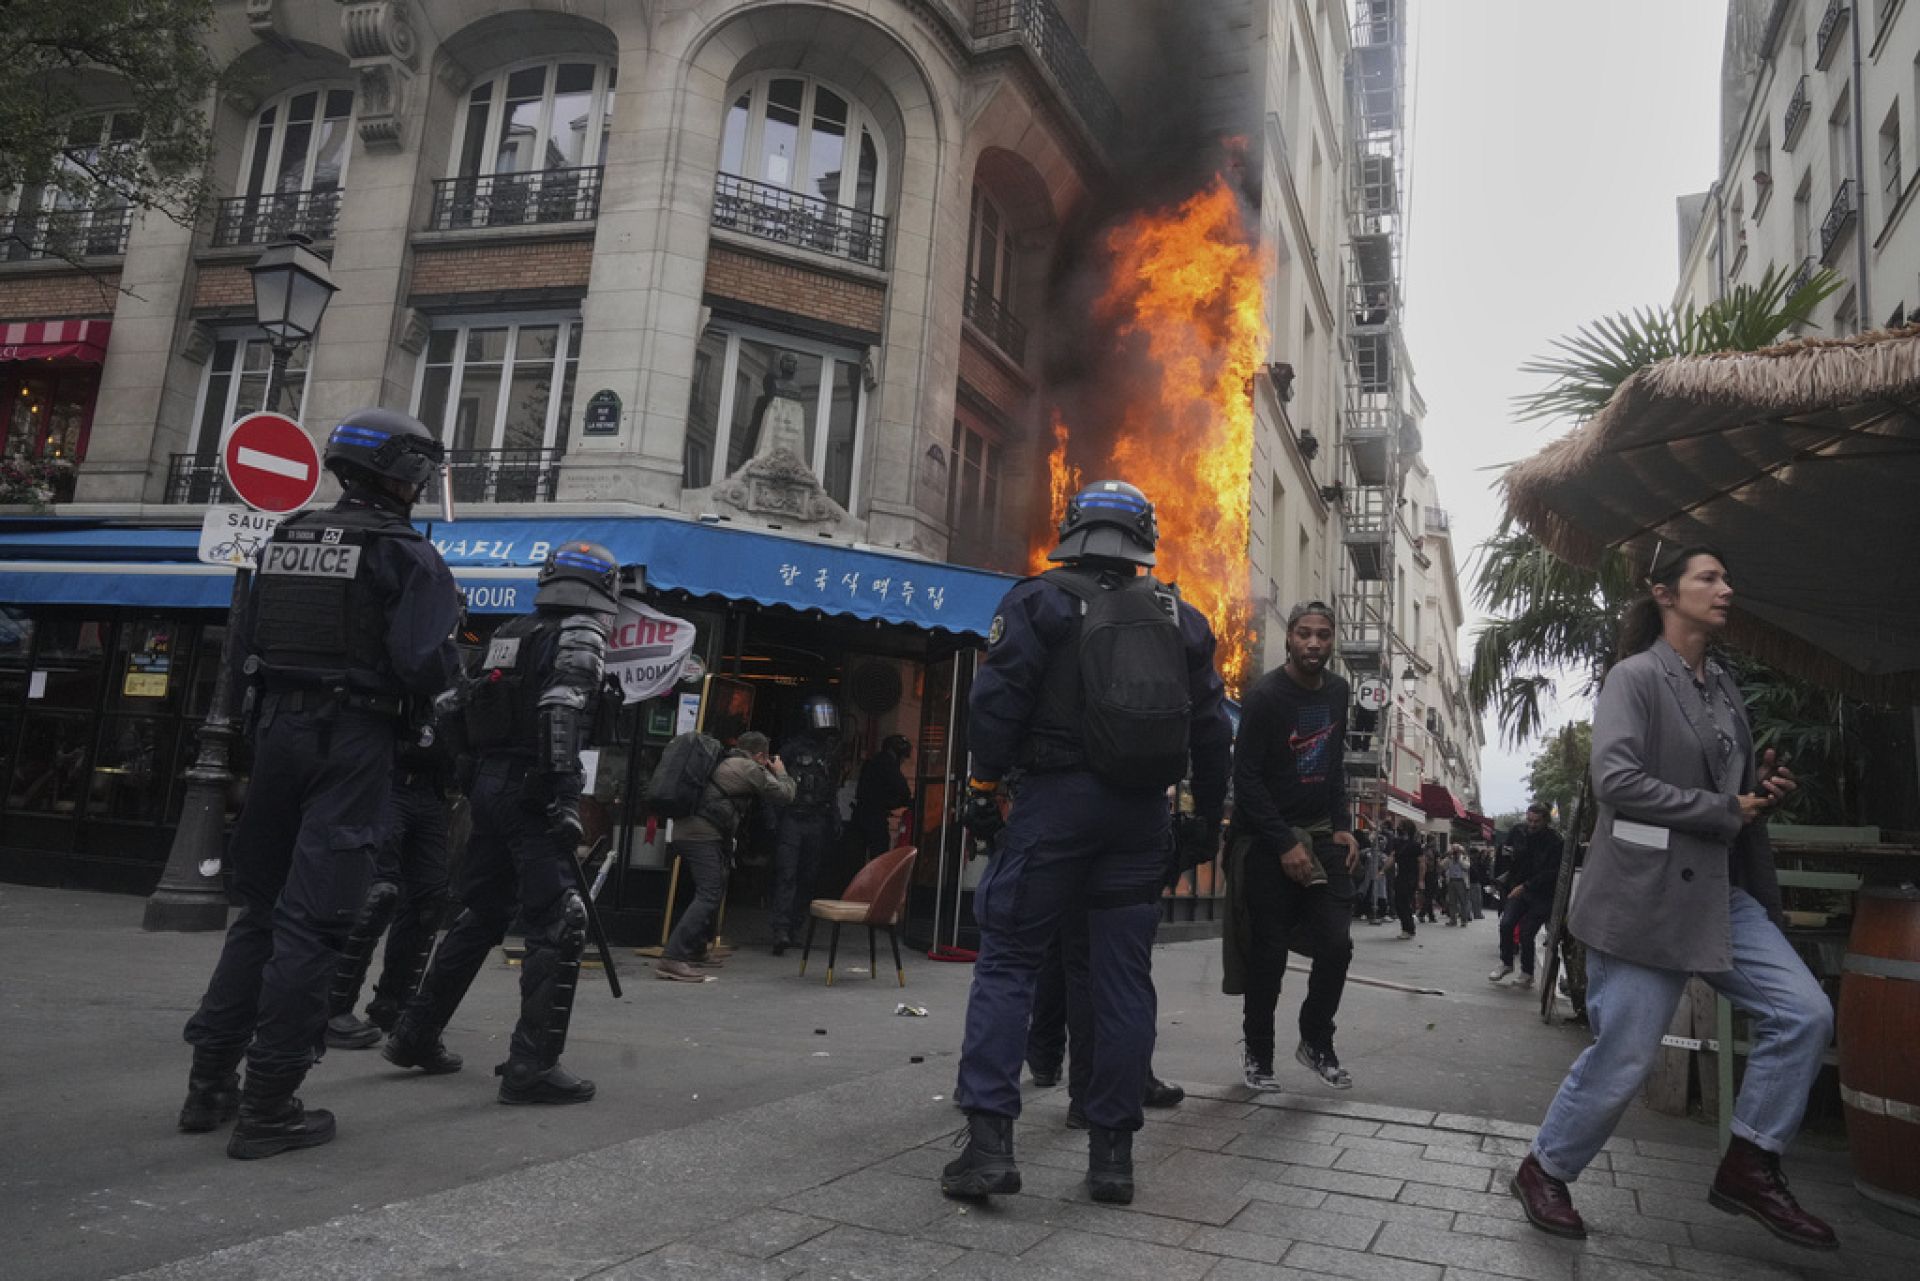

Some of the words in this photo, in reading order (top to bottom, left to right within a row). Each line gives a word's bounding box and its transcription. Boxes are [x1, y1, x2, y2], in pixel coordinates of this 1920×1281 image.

[228, 513, 276, 531] SAUF
[267, 545, 351, 573] POLICE
[462, 587, 517, 607] HOUR
[1361, 687, 1386, 702] PB
